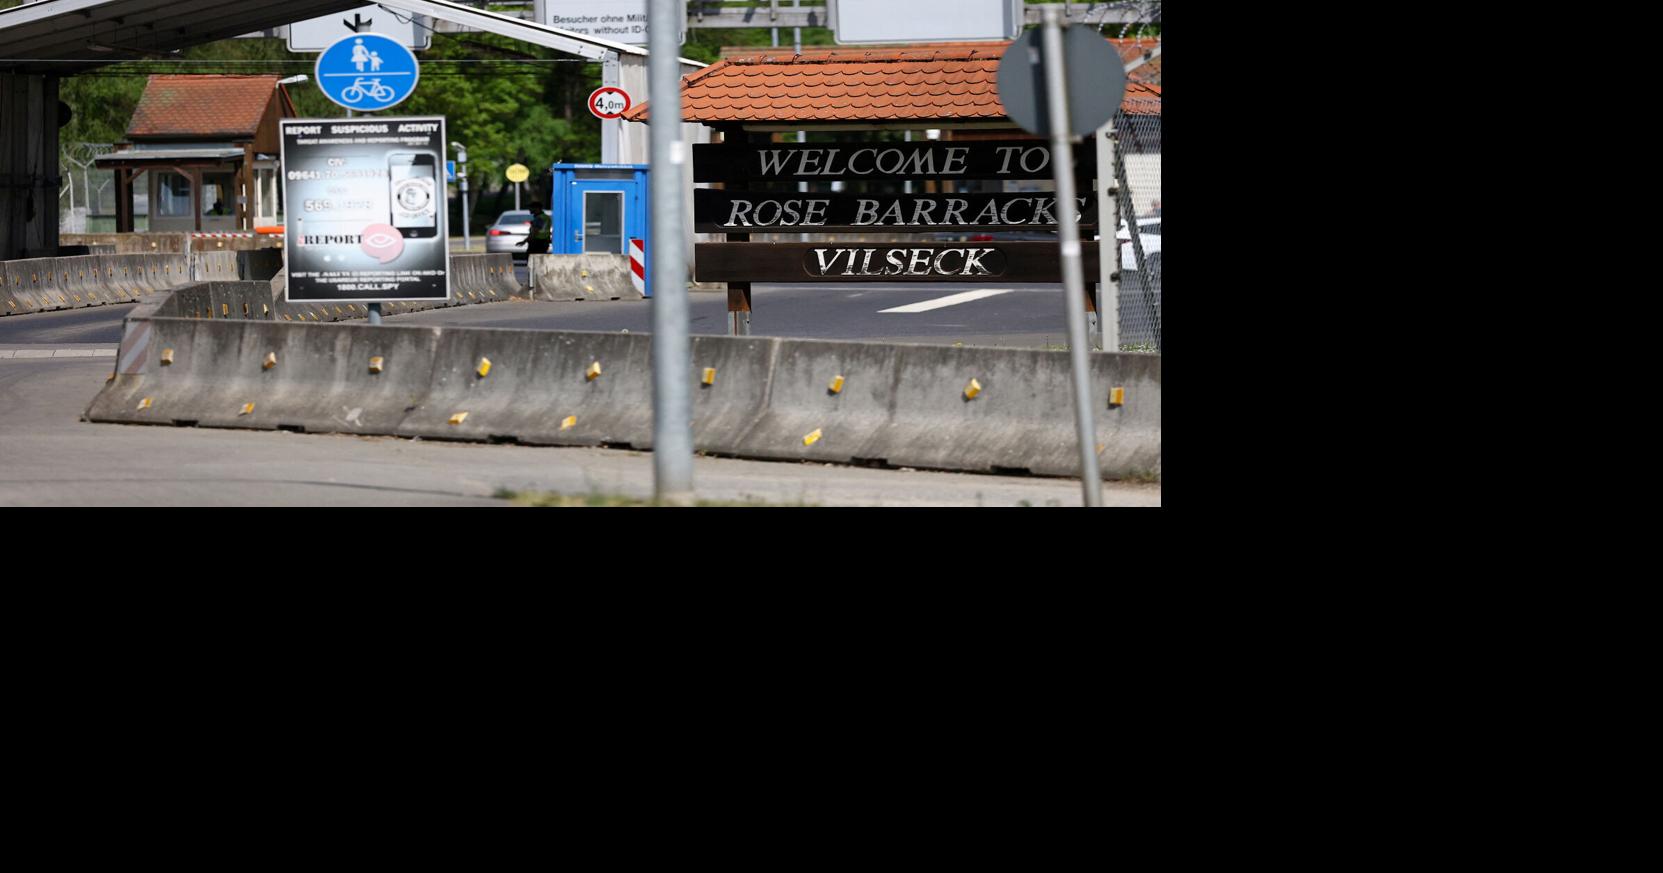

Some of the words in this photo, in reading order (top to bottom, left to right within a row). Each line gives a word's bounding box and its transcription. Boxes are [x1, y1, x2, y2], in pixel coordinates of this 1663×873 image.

[553, 15, 598, 24] Besucher
[600, 14, 624, 23] ohne
[594, 26, 629, 35] without
[285, 126, 322, 135] REPORT
[331, 124, 389, 134] SUSPICIOUS
[398, 123, 439, 133] ACTIVITY
[757, 147, 969, 176] WELCOME
[996, 146, 1051, 174] TO
[723, 199, 830, 227] ROSE
[813, 248, 995, 276] VILSECK
